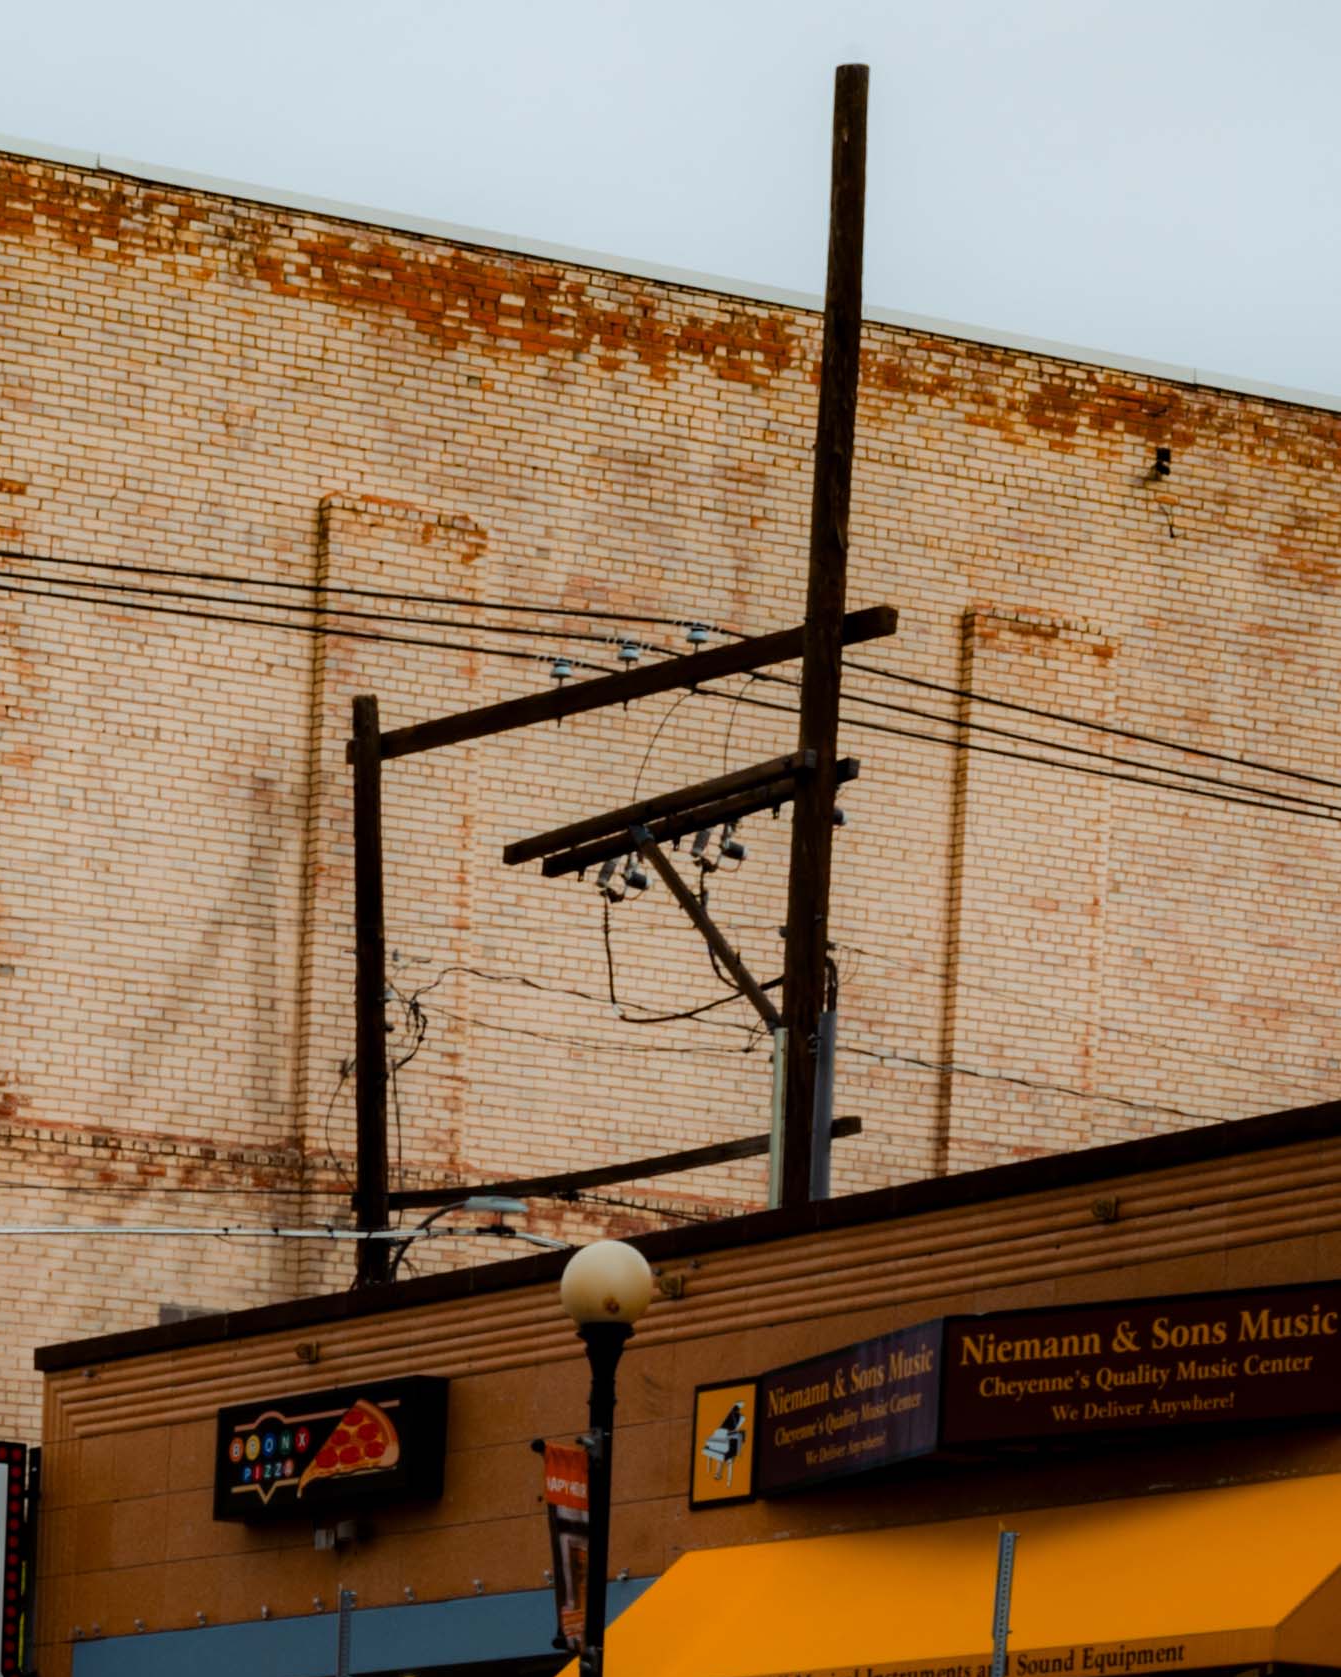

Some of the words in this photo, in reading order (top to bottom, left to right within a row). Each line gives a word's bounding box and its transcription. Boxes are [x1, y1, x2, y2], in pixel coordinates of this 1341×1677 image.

[959, 1333, 1101, 1366] Niemann
[1112, 1321, 1141, 1353] &
[1152, 1317, 1227, 1350] Sons
[1238, 1304, 1339, 1342] Music
[768, 1381, 830, 1418] Niemann
[833, 1367, 848, 1399] &
[850, 1363, 885, 1394] Sons
[888, 1344, 934, 1382] Music
[979, 1370, 1091, 1402] Cheyenne's
[1096, 1364, 1170, 1391] Quality
[1176, 1357, 1238, 1383] Music
[1243, 1354, 1314, 1376] Center
[1051, 1405, 1079, 1423] We
[1084, 1401, 1142, 1420] Deliver
[1148, 1391, 1236, 1419] Anywhere!
[1017, 1650, 1075, 1677] Sound
[1082, 1644, 1186, 1672] Equipment
